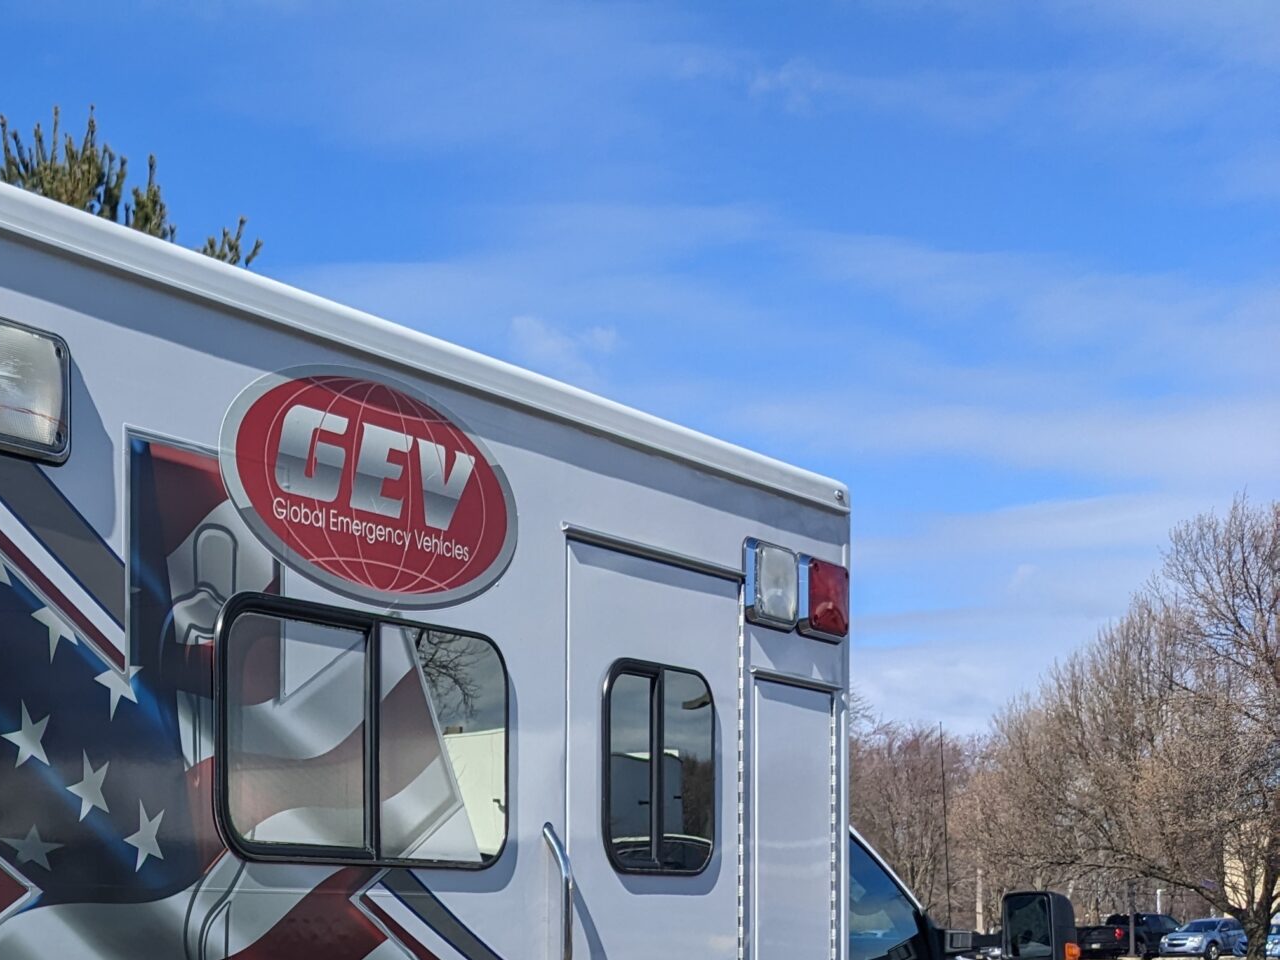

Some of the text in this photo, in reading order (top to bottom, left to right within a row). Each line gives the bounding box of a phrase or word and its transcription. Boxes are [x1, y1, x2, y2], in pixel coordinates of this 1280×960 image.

[274, 404, 476, 531] GEV
[272, 497, 470, 562] Global Emergency Vehicles
